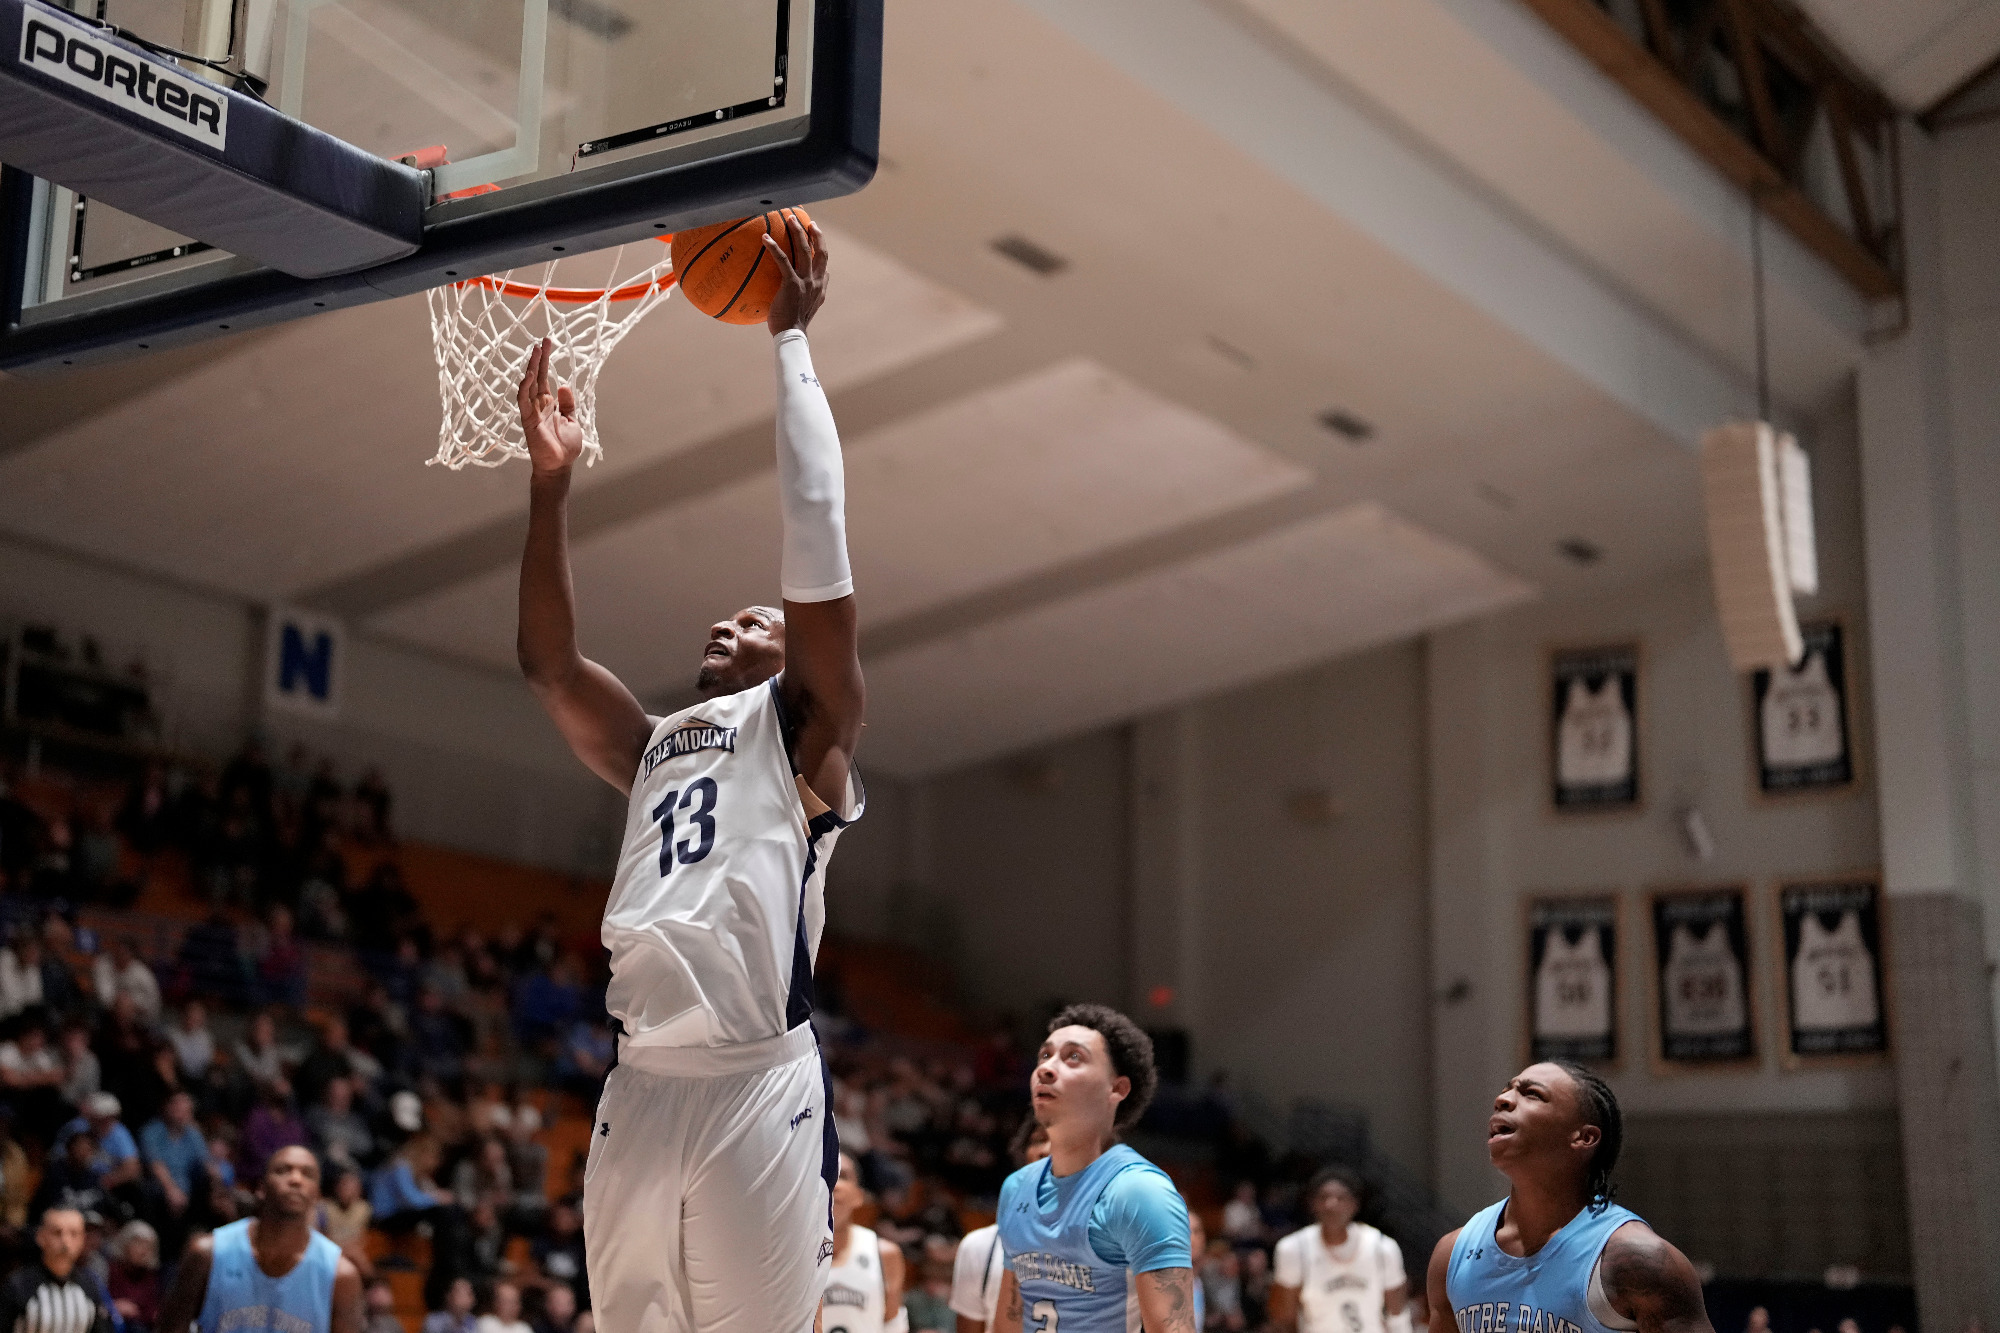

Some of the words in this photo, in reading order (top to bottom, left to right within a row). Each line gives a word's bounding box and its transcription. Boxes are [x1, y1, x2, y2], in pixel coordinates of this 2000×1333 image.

[720, 244, 736, 264] NXT
[279, 620, 333, 700] N
[644, 738, 671, 780] THE
[674, 727, 737, 753] MOUNT
[652, 776, 718, 879] 13
[1043, 1252, 1096, 1293] DAME
